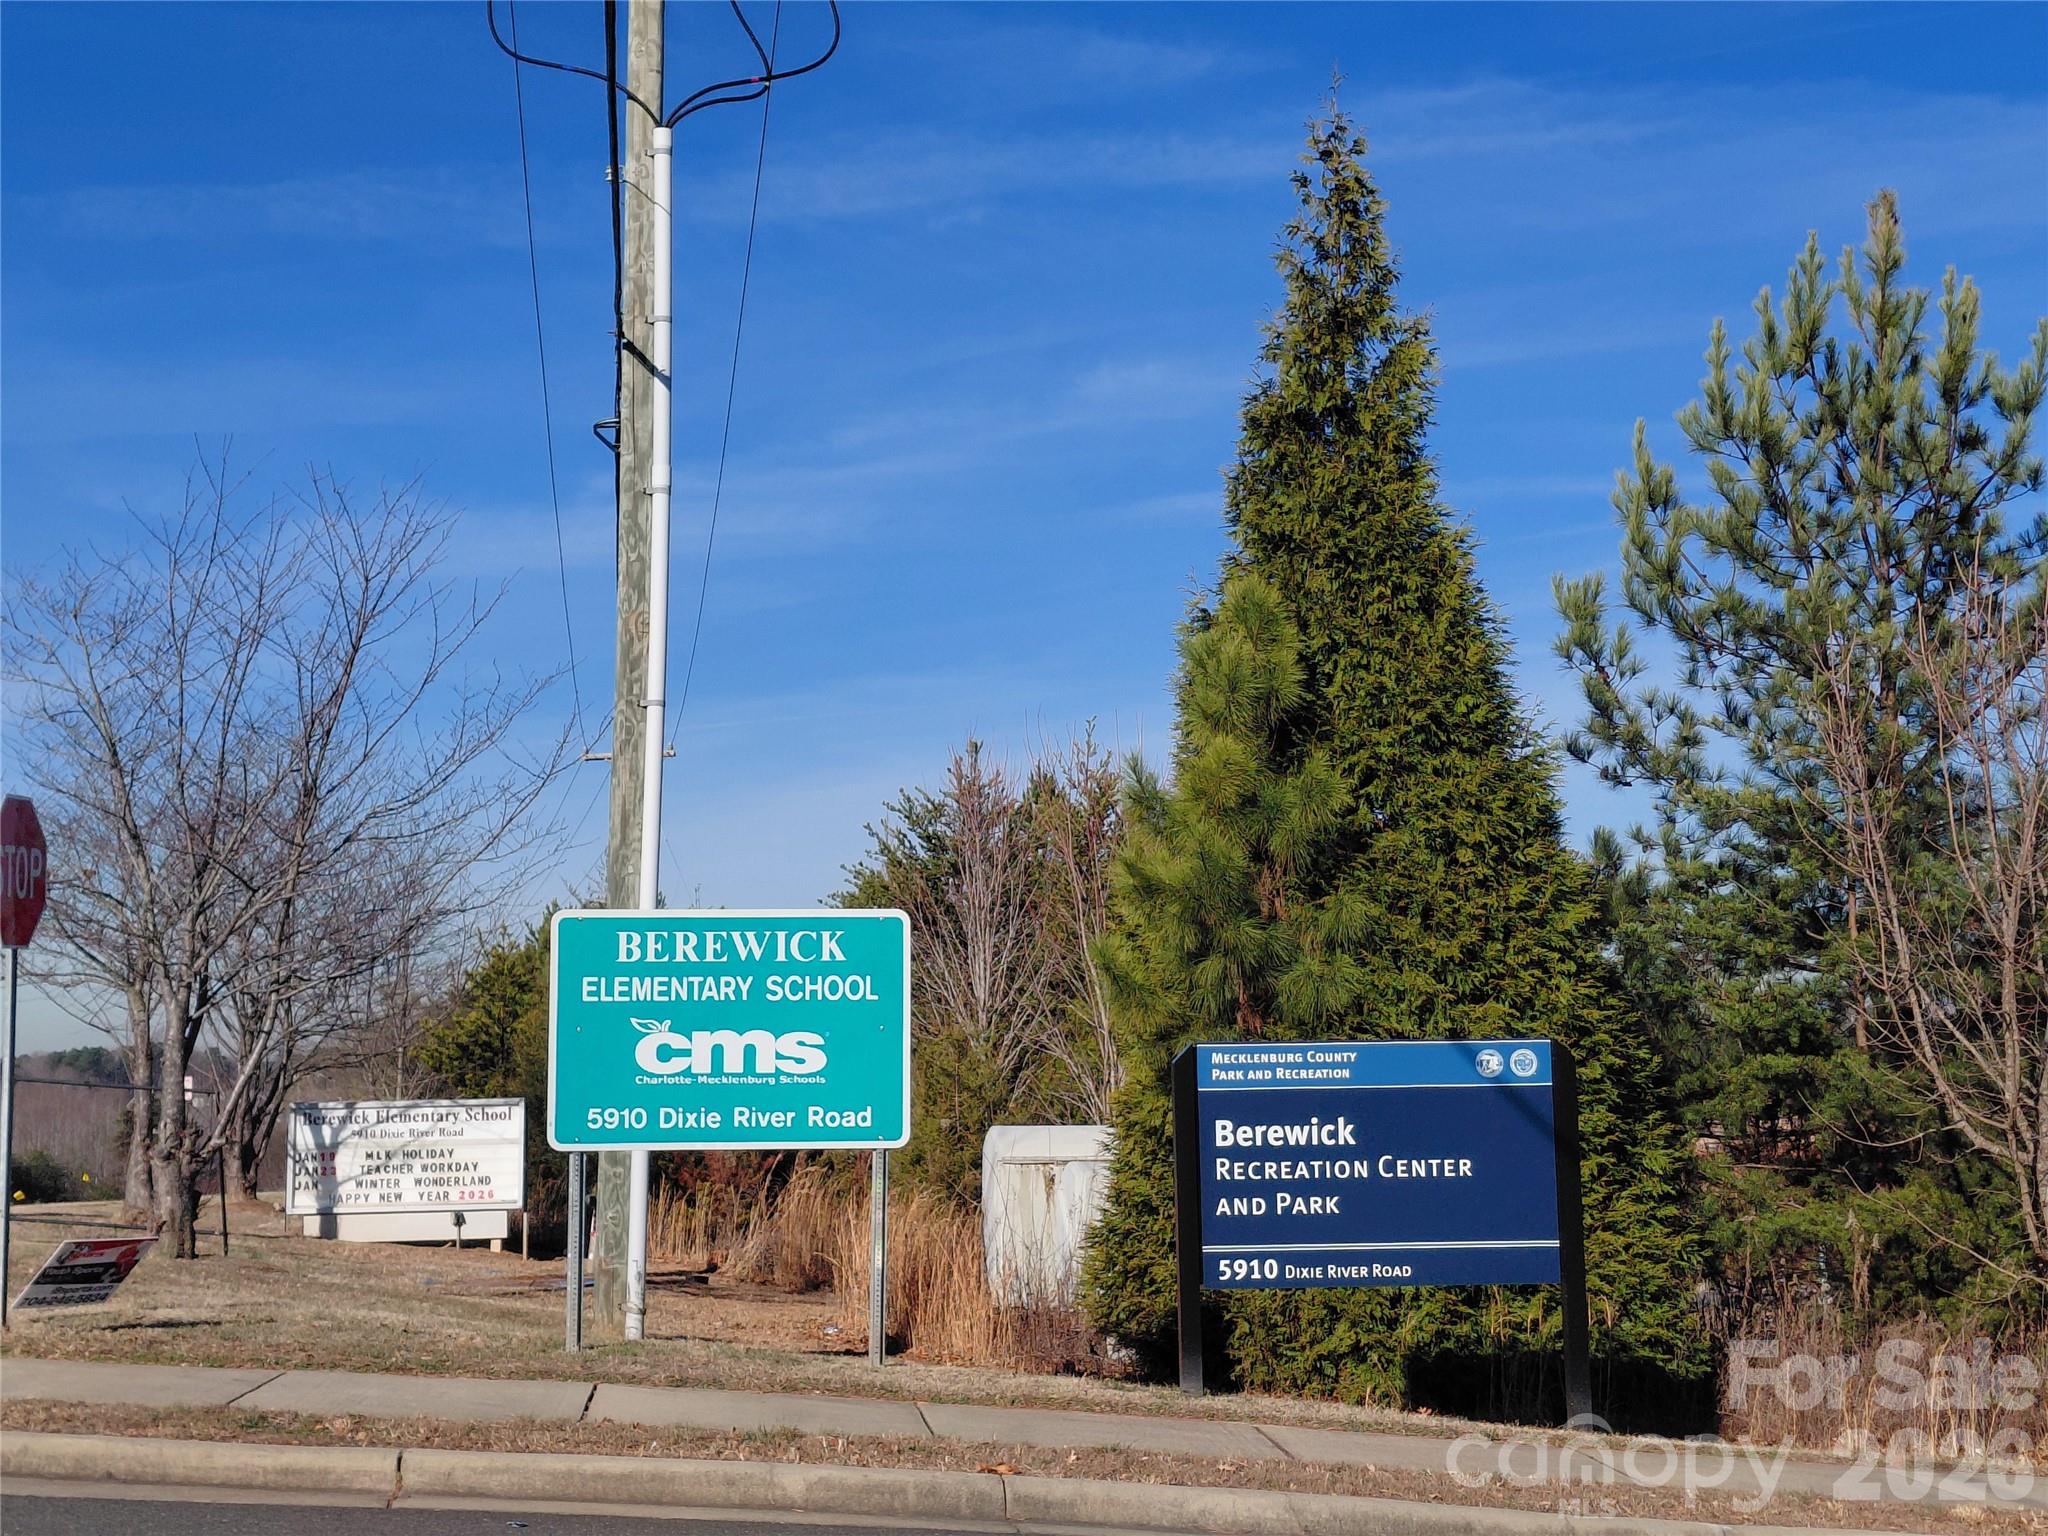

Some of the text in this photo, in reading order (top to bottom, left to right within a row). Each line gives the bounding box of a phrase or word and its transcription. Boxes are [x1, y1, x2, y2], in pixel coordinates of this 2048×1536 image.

[616, 930, 847, 962] BEREWICK
[582, 974, 879, 1002] ELEMENTARY SCHOOL
[635, 1029, 828, 1074] cms
[635, 1075, 827, 1086] Charlotte-Mecklenburg Schools
[303, 1106, 512, 1126] Berewick Elementary School
[587, 1106, 873, 1129] 5910 Dixie River Road
[380, 1128, 405, 1139] Dixie
[409, 1127, 435, 1138] River
[439, 1127, 464, 1137] Road
[1214, 1116, 1357, 1148] Berewick
[295, 1152, 317, 1164] JAN
[365, 1149, 392, 1160] MLK
[402, 1148, 455, 1160] HOLIDAY
[295, 1165, 319, 1177] JAN
[360, 1163, 414, 1175] TEACHER
[420, 1161, 479, 1173] WORKDAY
[295, 1175, 492, 1191] JAN WINTER WONDERLAND
[329, 1189, 494, 1205] HAPPY NEW YEAR 2026
[1218, 1258, 1278, 1281] 5910
